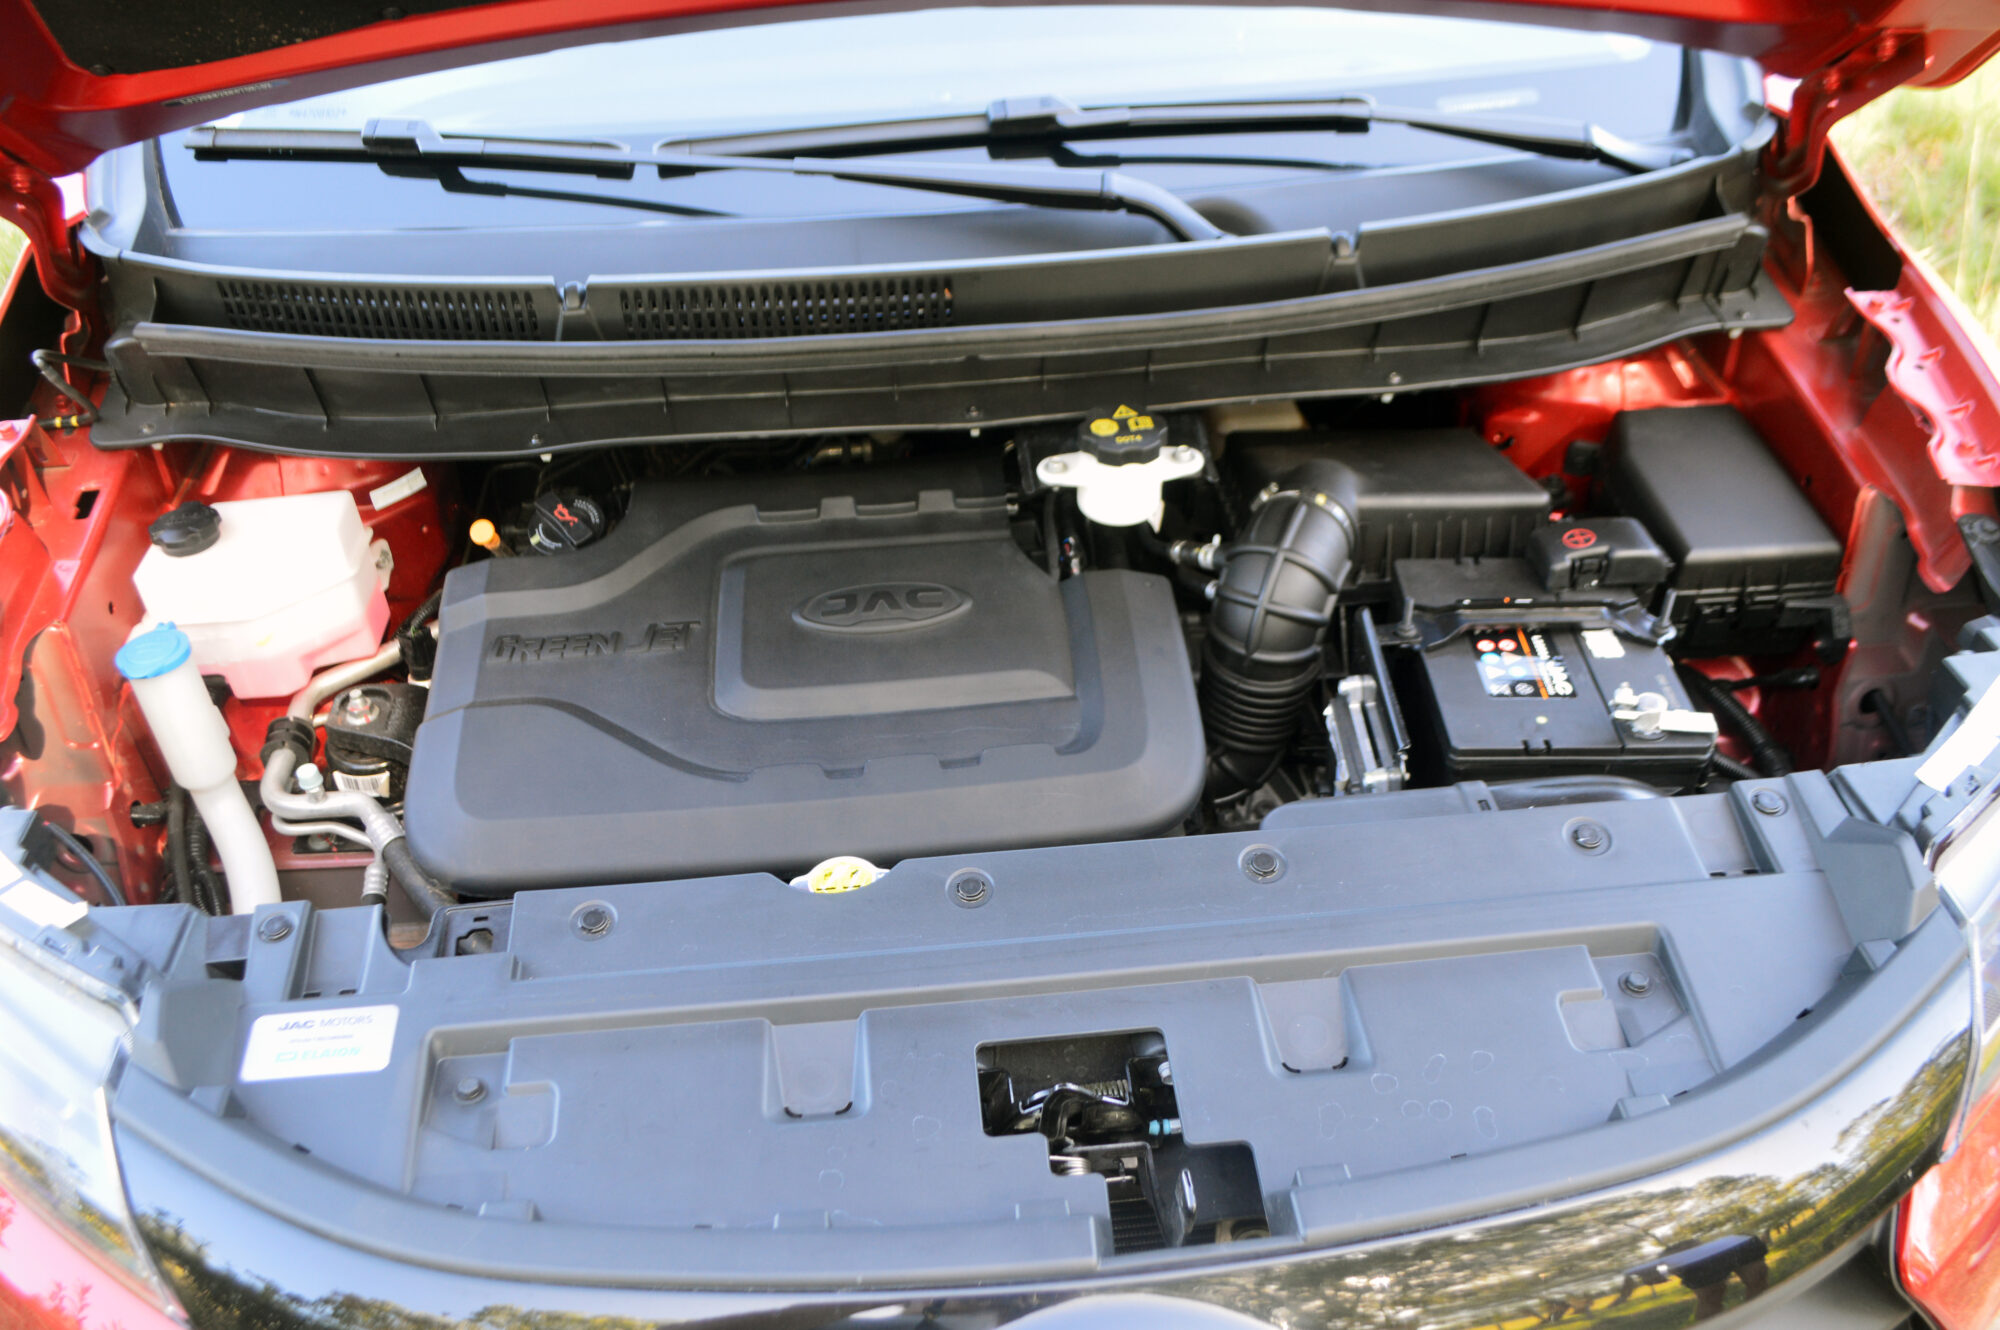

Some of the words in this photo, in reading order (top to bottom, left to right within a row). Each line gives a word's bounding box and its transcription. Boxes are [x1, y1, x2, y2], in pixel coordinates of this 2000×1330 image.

[821, 587, 945, 618] JAC
[489, 631, 624, 664] GREEN
[628, 619, 701, 654] JET
[277, 1019, 316, 1031] JAC
[319, 1014, 374, 1027] MOTORS
